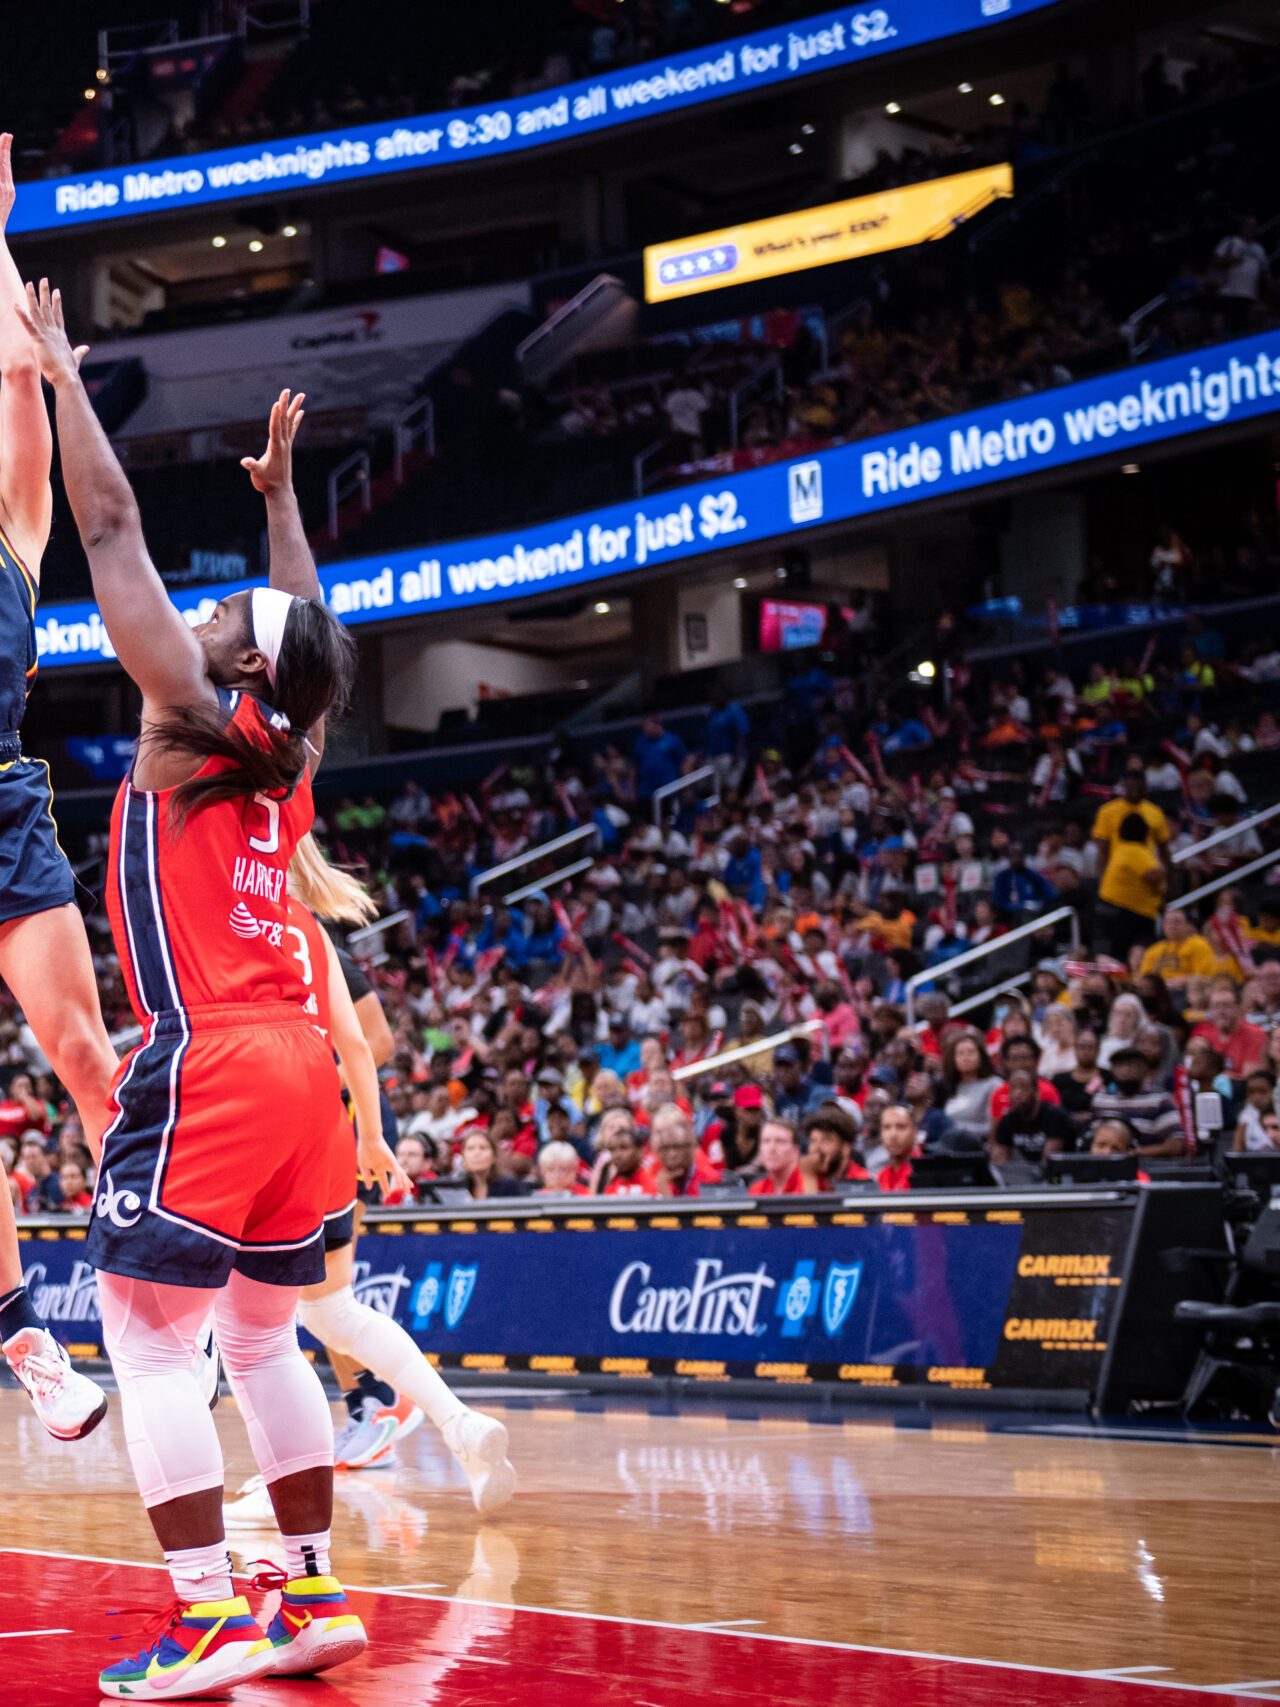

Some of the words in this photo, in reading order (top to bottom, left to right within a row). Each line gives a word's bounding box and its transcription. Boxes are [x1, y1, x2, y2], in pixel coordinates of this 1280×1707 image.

[55, 180, 119, 214] Ride
[123, 168, 203, 202] Metro
[208, 138, 370, 188] weeknights
[376, 128, 443, 160] after
[447, 111, 512, 148] 9:30
[516, 95, 569, 136] and
[573, 85, 607, 120] all
[611, 51, 735, 110] weekend
[740, 42, 783, 76] for
[787, 21, 846, 71] just
[851, 8, 898, 46] $2.
[861, 443, 942, 498] Ride
[949, 417, 1055, 475] Metro
[331, 568, 394, 613] and
[400, 560, 441, 603] all
[448, 531, 584, 594] weekend
[588, 523, 631, 566] for
[635, 502, 694, 565] just
[698, 490, 747, 541] $2.
[609, 1257, 776, 1336] CareFirst
